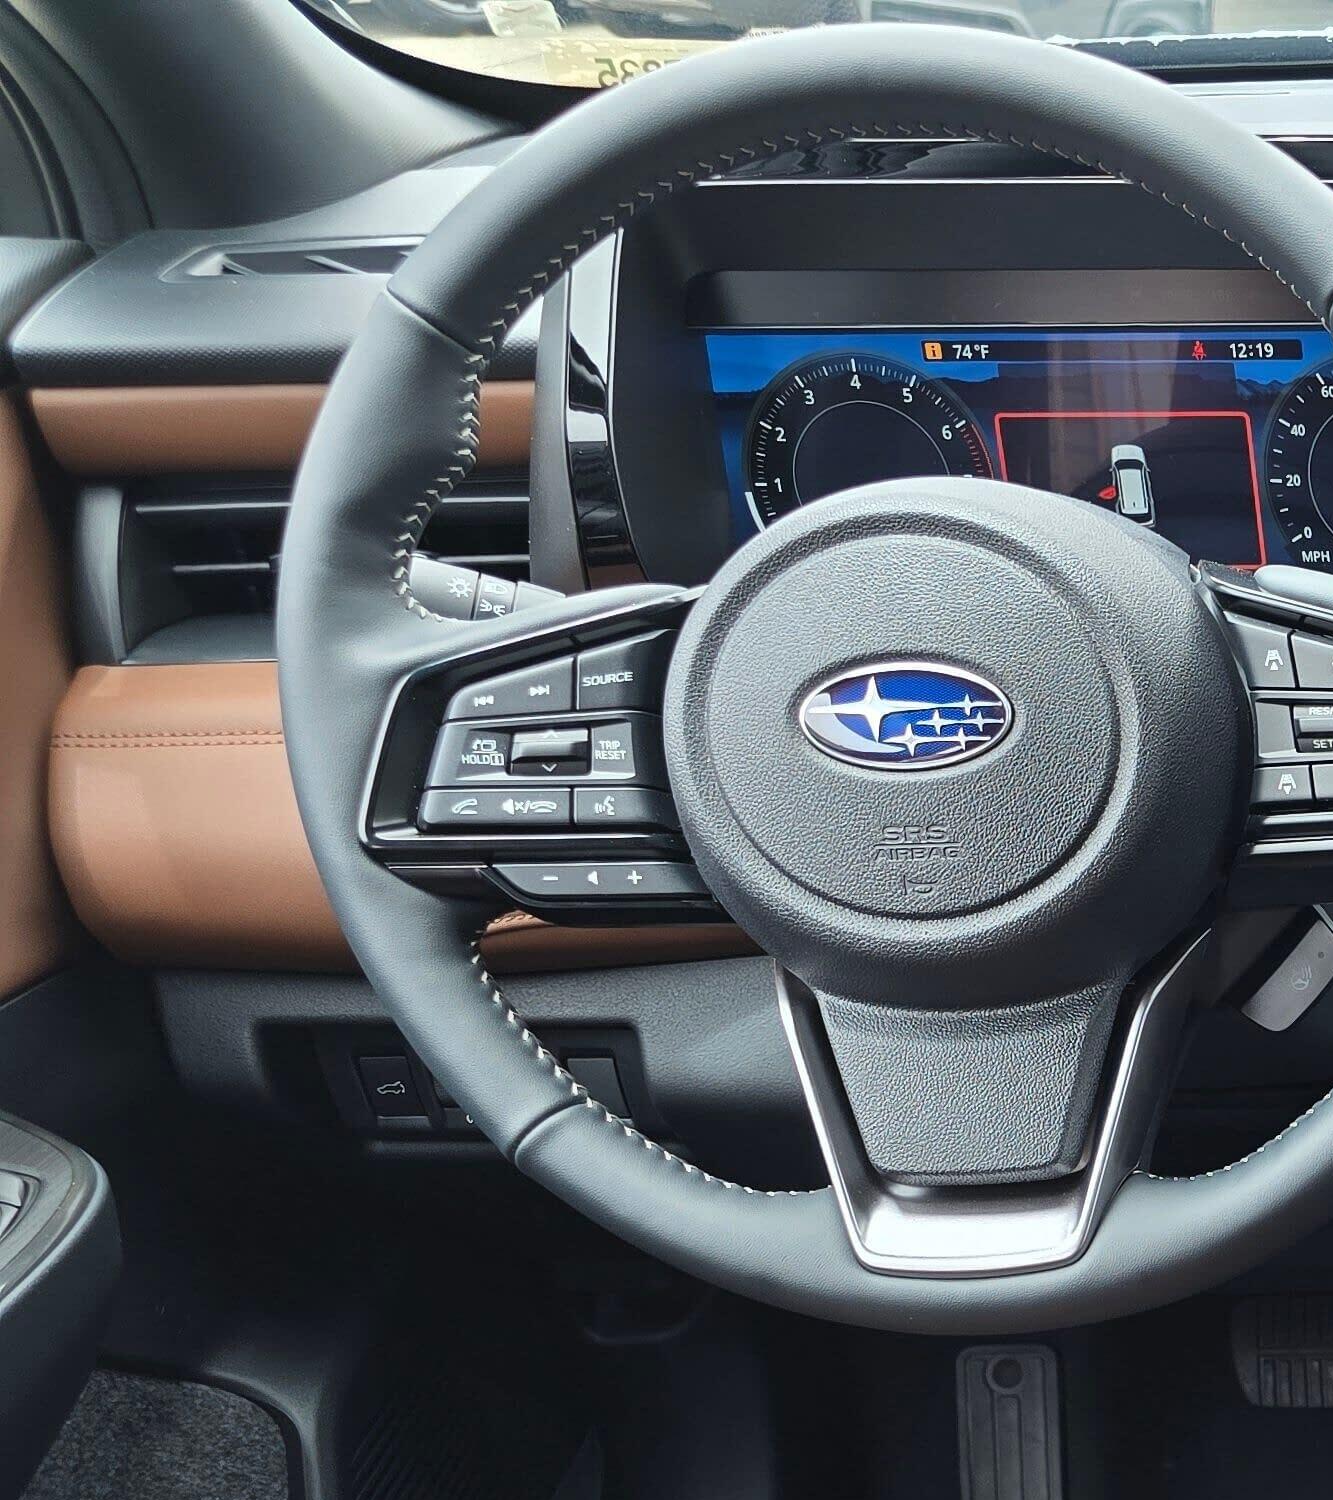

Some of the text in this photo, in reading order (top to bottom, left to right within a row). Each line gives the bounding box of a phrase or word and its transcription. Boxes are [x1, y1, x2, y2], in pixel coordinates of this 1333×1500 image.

[952, 344, 989, 360] 74°F
[1229, 342, 1274, 359] 12:19
[850, 375, 862, 389] 4
[803, 390, 815, 405] 3
[902, 388, 913, 403] 5
[775, 428, 787, 442] 2
[941, 425, 953, 440] 6
[1290, 423, 1306, 437] 40
[774, 477, 783, 492] 1
[1285, 474, 1301, 488] 20
[1304, 525, 1313, 540] 0
[1301, 550, 1331, 564] MPH
[582, 672, 634, 688] SOURCE
[599, 740, 621, 751] TRIP
[461, 754, 490, 766] HOLD
[595, 750, 627, 761] RESET
[881, 825, 949, 842] SRS
[873, 847, 961, 862] AIRBAG
